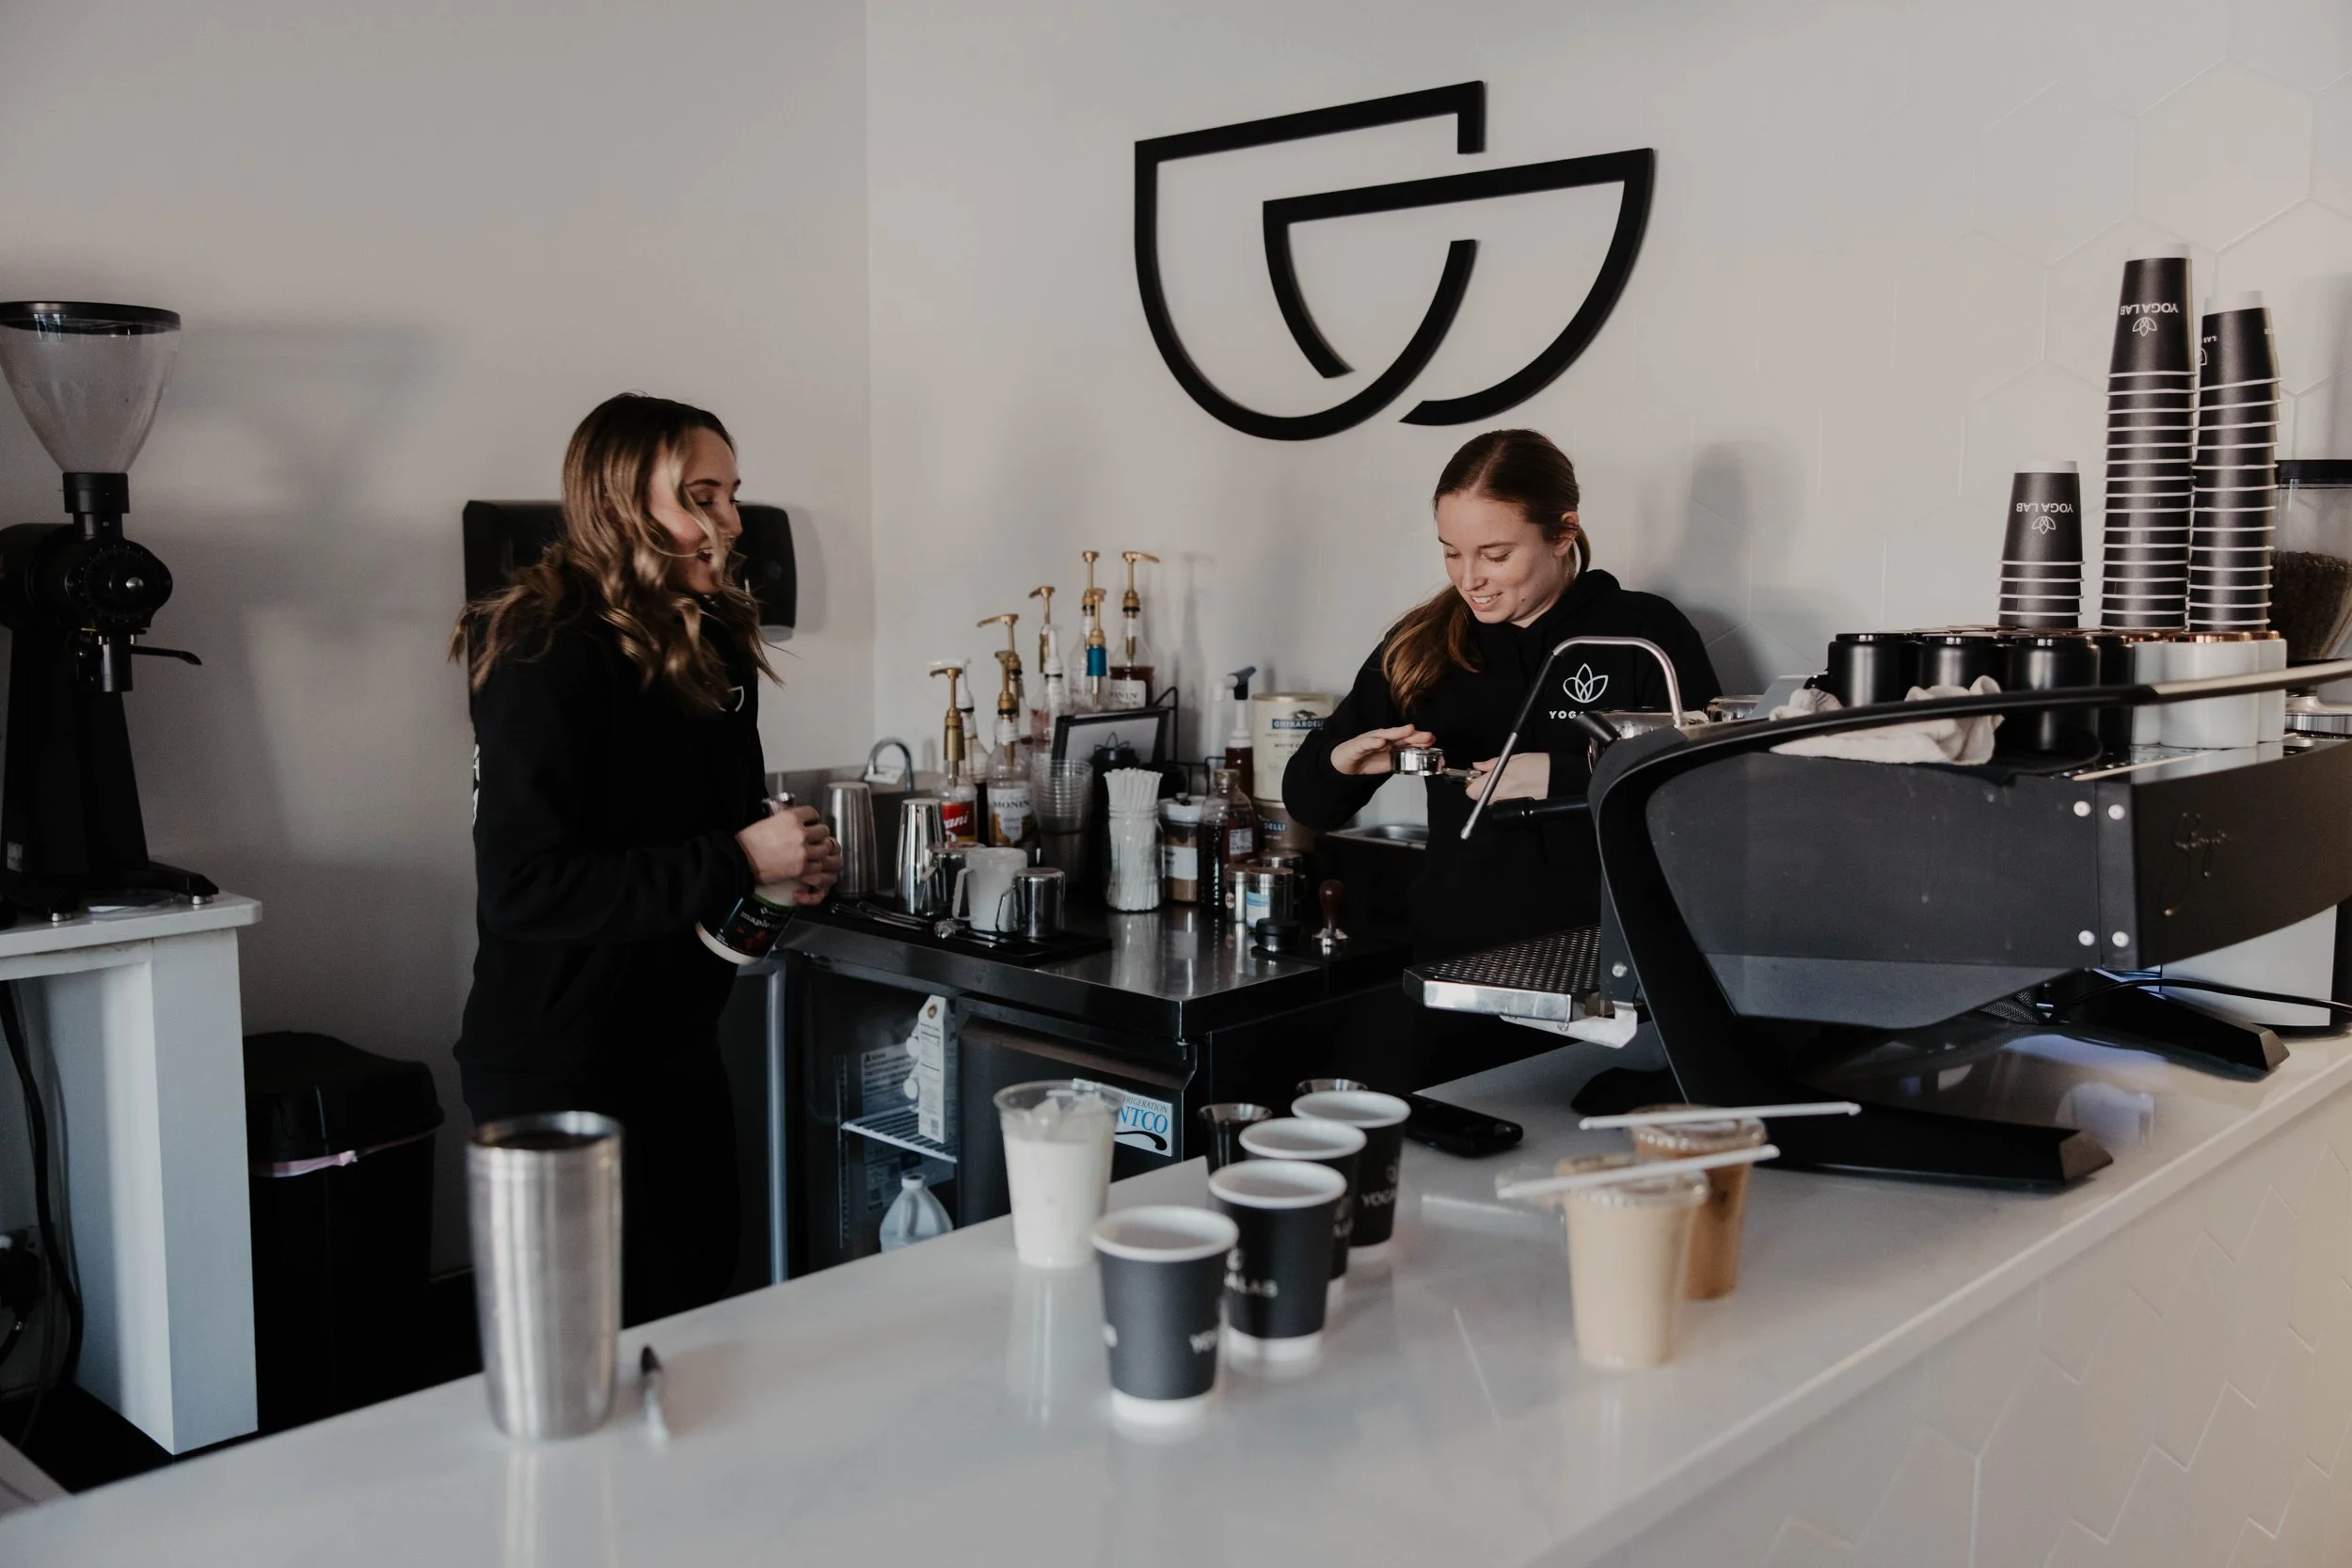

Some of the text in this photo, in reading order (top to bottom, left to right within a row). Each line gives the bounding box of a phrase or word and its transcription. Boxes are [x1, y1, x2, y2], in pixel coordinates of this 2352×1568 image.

[2120, 302, 2179, 315] YOGA LAB
[2016, 502, 2074, 513] YOGA LAB
[993, 800, 1029, 809] MONIN
[1123, 1096, 1168, 1113] FRIGERATION
[1117, 1106, 1168, 1134] NTCO
